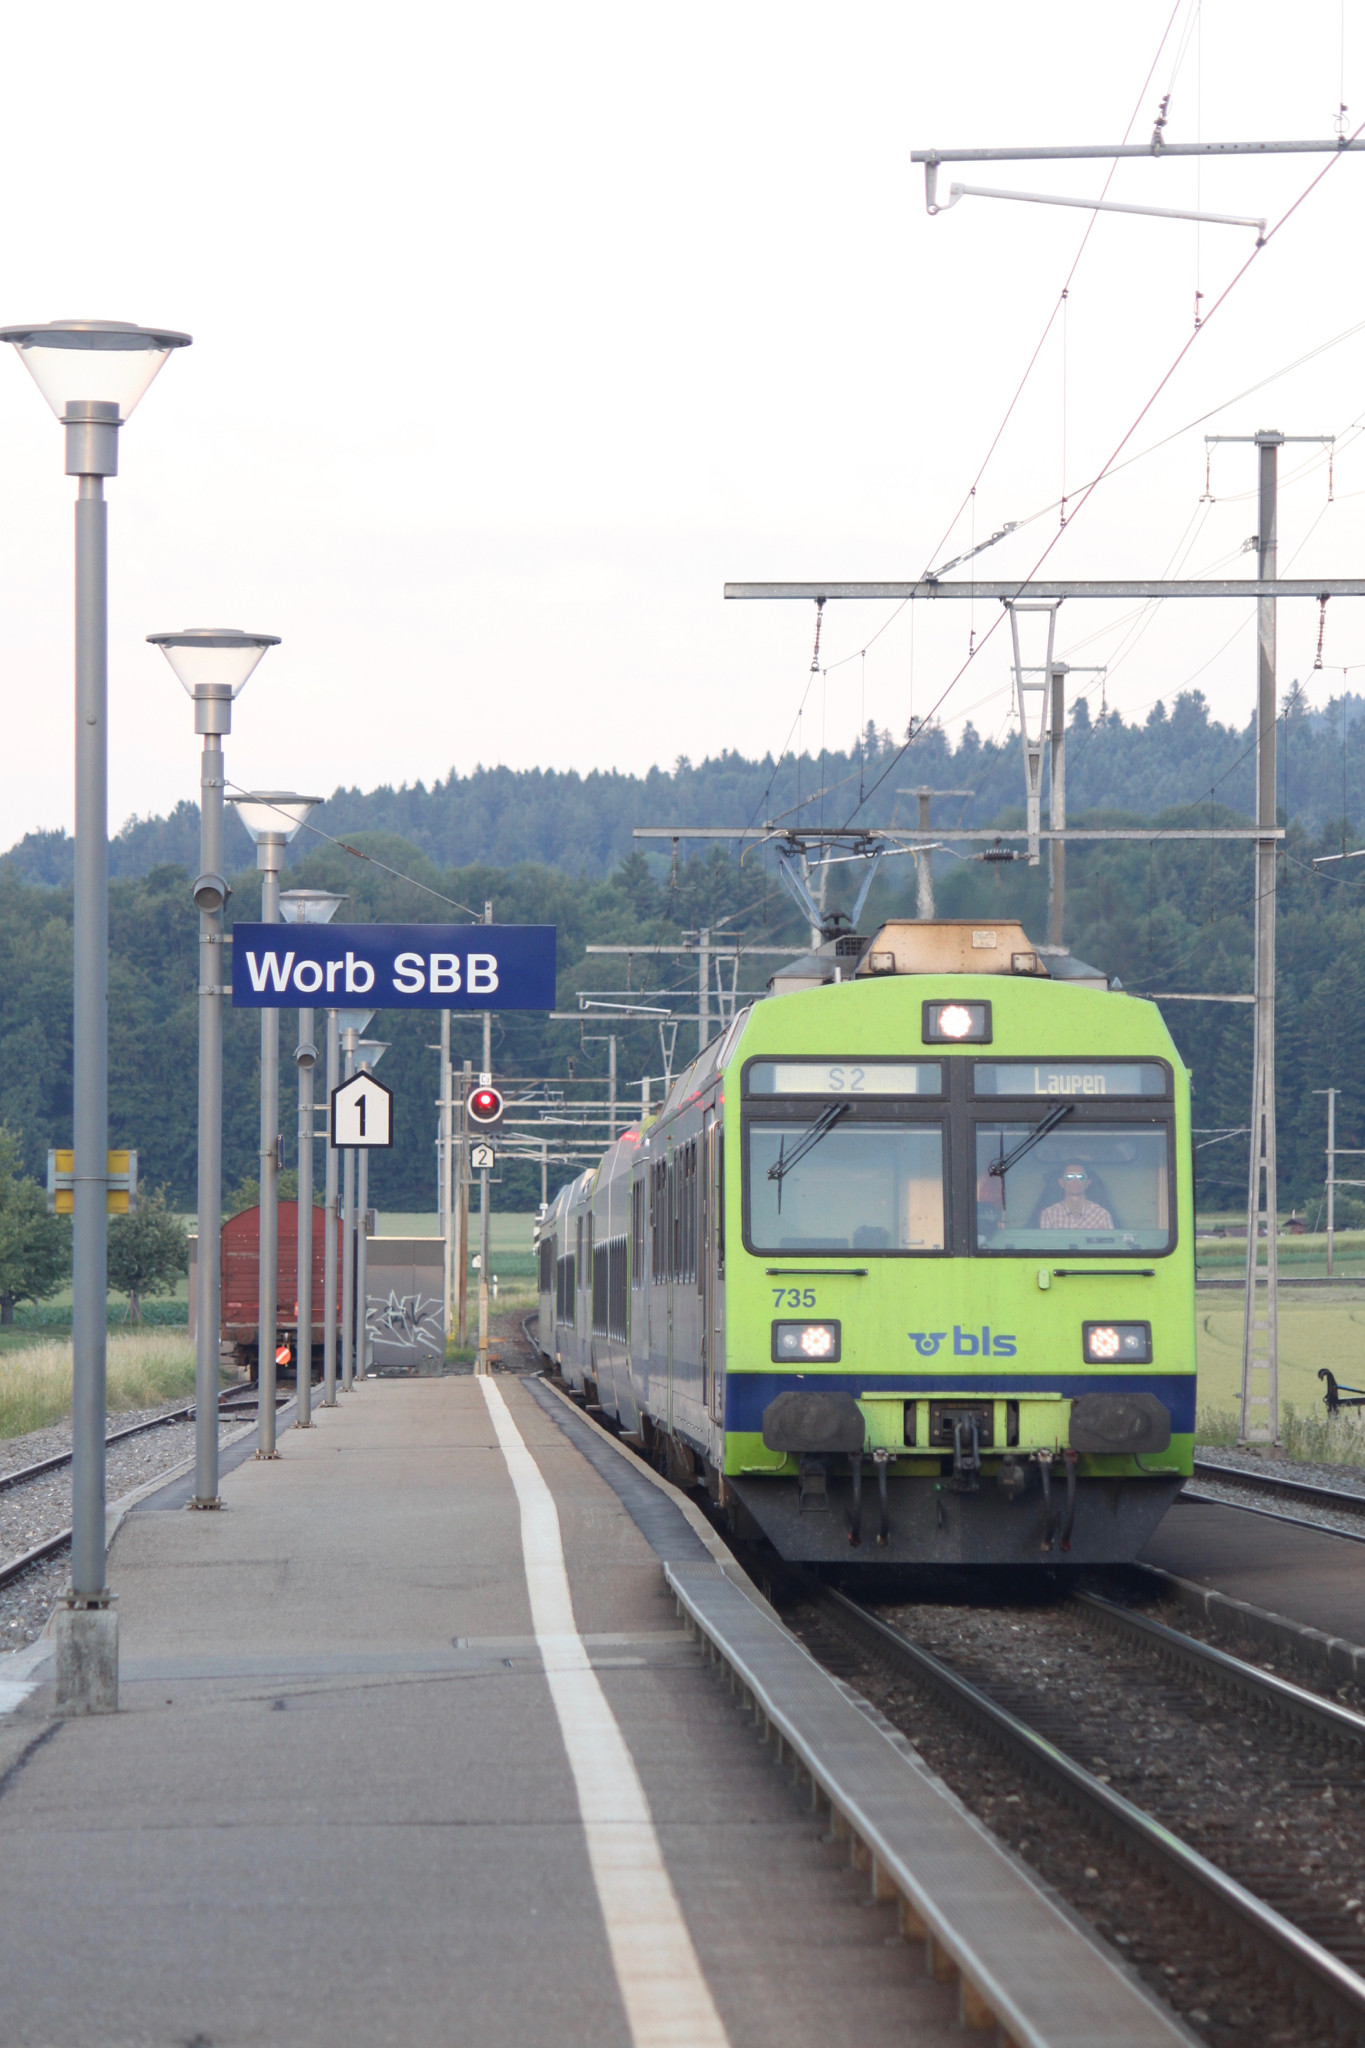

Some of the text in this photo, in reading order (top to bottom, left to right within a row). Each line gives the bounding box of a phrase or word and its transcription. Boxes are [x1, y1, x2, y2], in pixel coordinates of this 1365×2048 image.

[245, 951, 499, 994] Worb SBB
[1034, 1066, 1107, 1095] Laupen
[354, 1093, 366, 1137] 1
[478, 1148, 488, 1166] 2
[771, 1288, 817, 1309] 735
[953, 1325, 1018, 1357] bls
